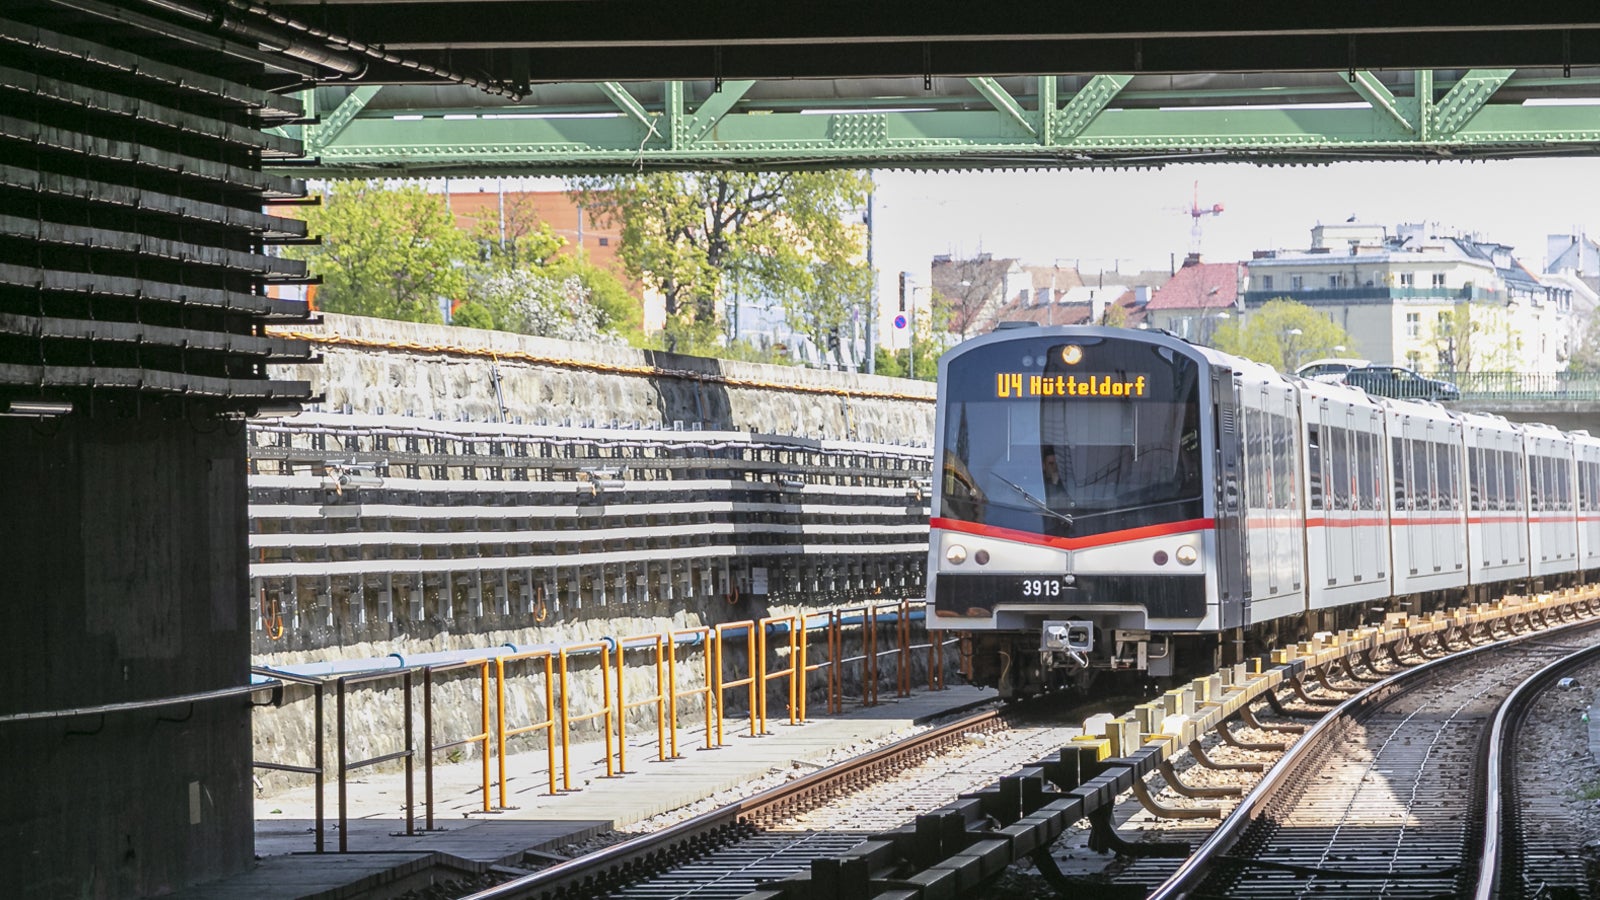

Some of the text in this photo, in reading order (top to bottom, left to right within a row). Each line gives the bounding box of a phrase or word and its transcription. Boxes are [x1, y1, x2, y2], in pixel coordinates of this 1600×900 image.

[997, 373, 1146, 398] U4 Hütteldorf
[1022, 580, 1060, 596] 3913
